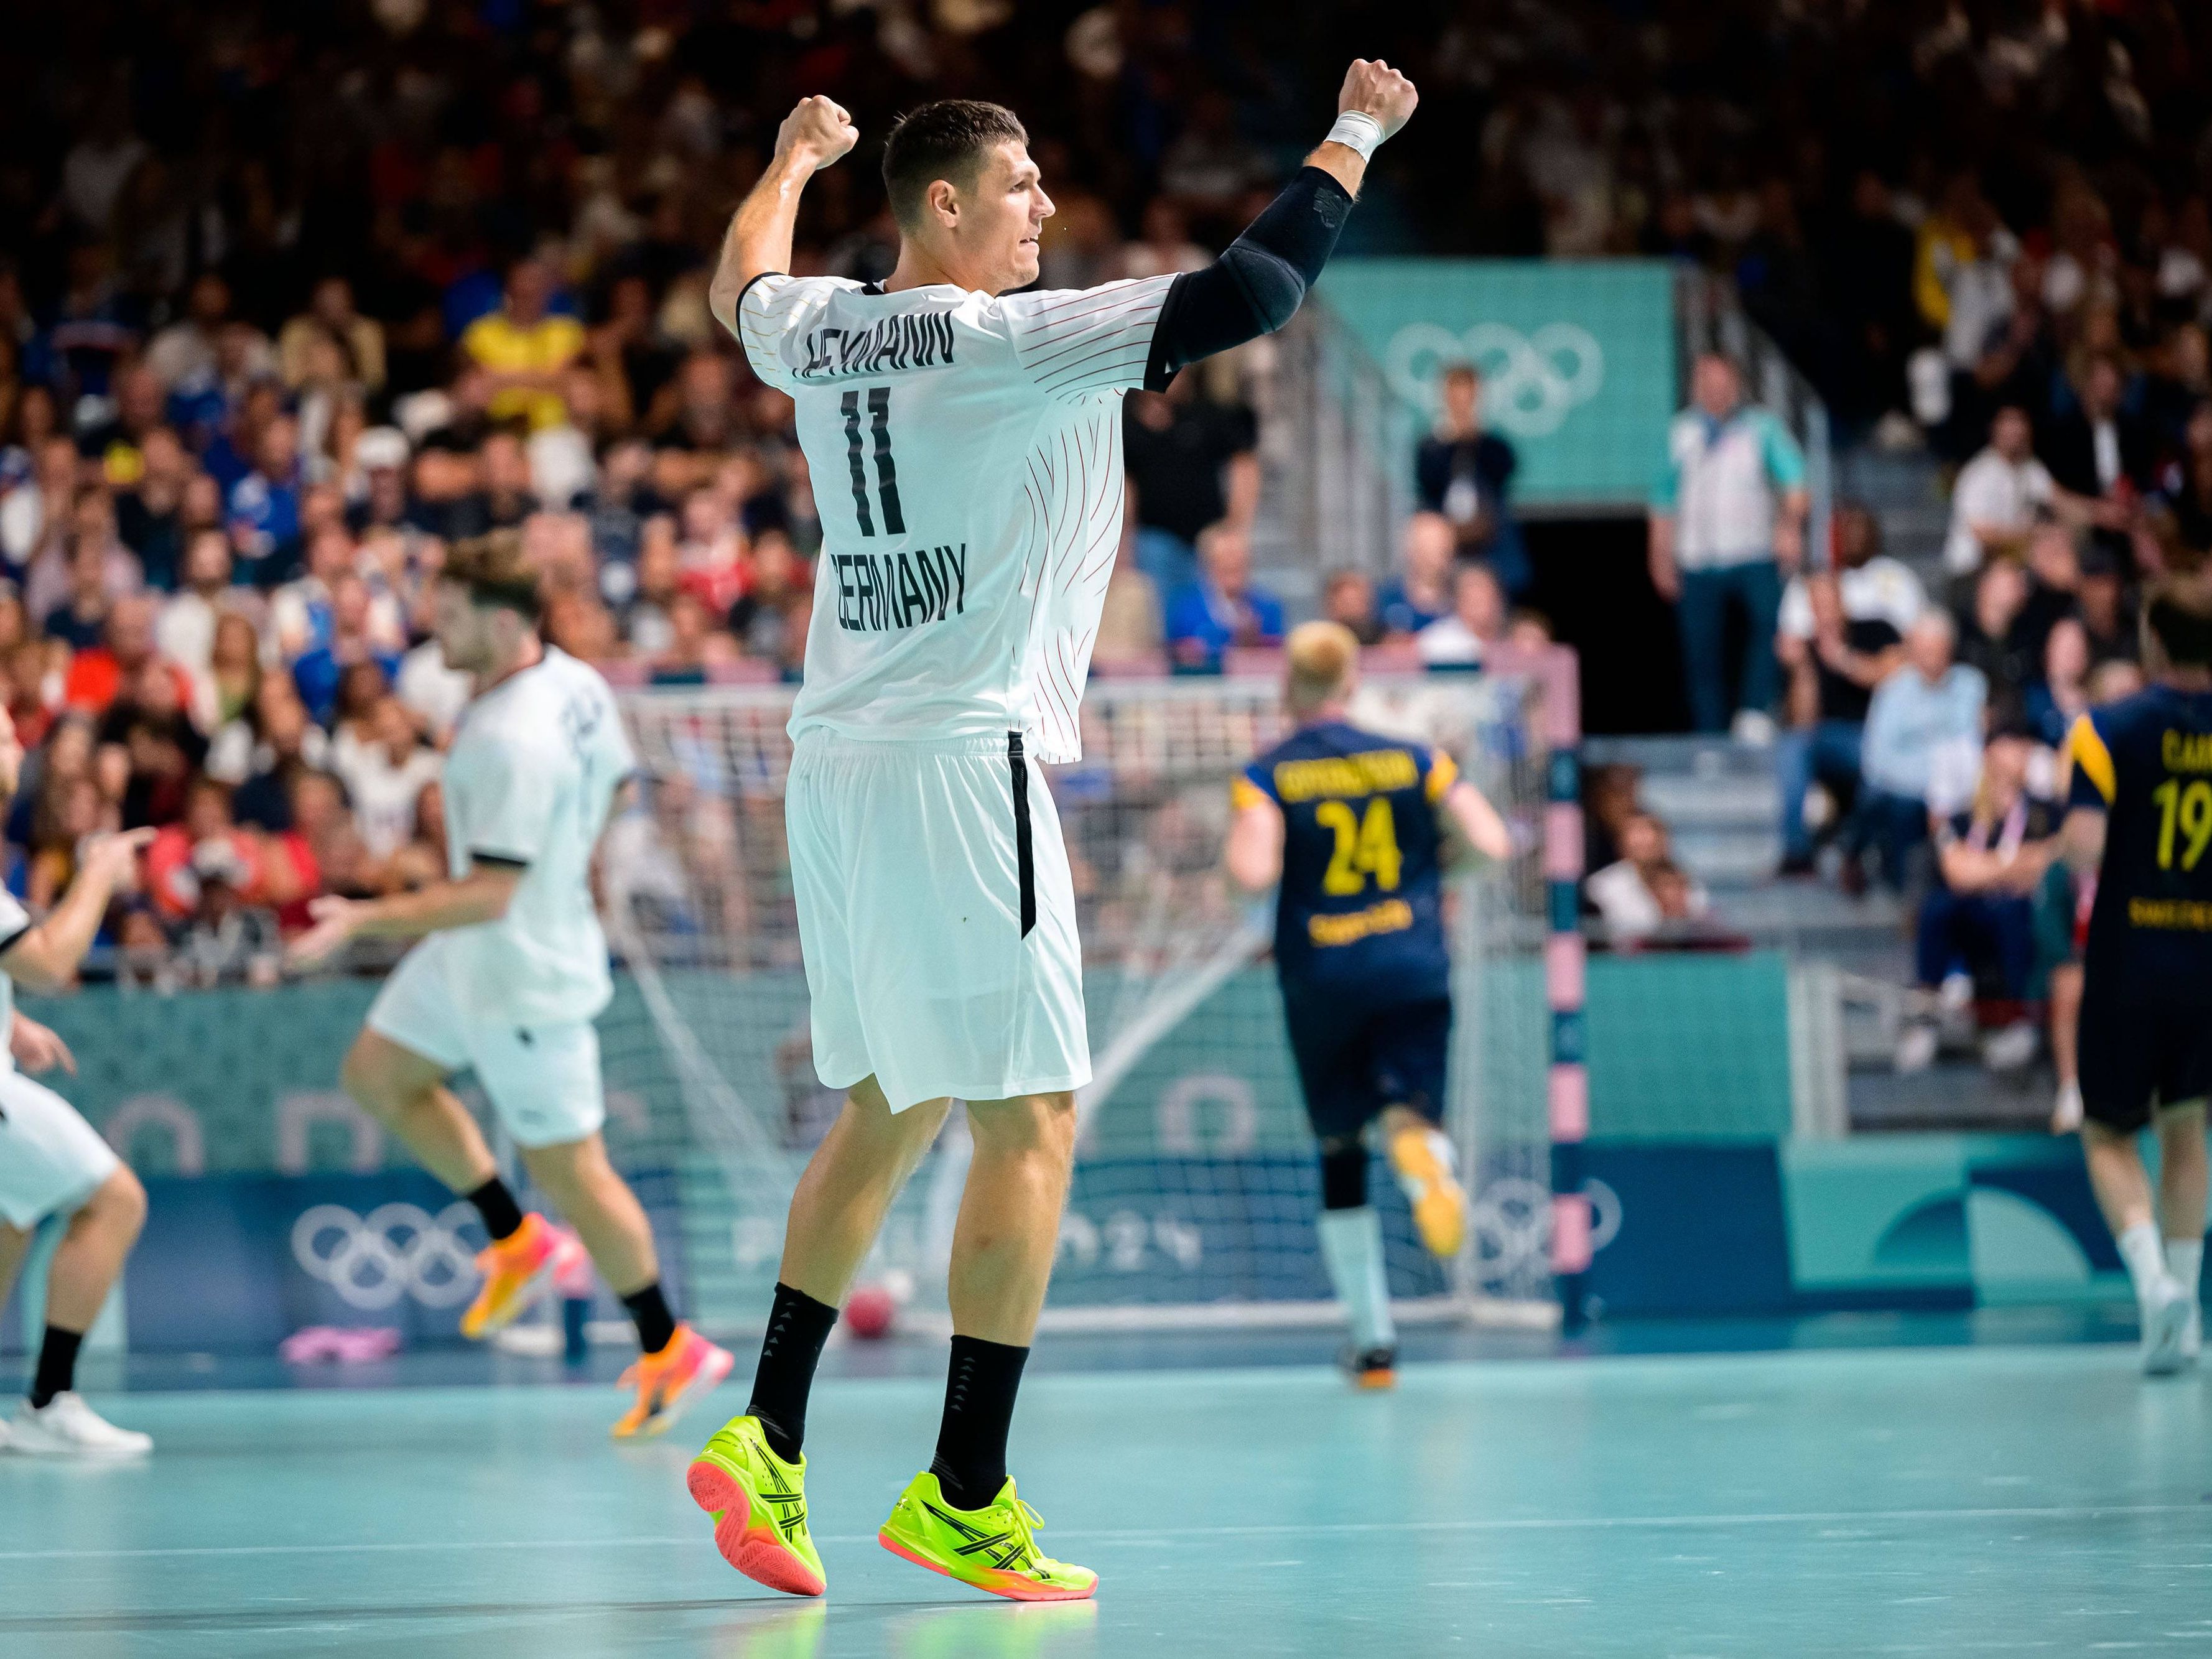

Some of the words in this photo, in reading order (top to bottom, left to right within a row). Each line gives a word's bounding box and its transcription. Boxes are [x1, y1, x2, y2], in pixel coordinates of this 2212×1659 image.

[840, 387, 906, 537] 11
[830, 543, 966, 631] GERMANY
[1316, 798, 1403, 896] 24
[2153, 779, 2212, 871] 19
